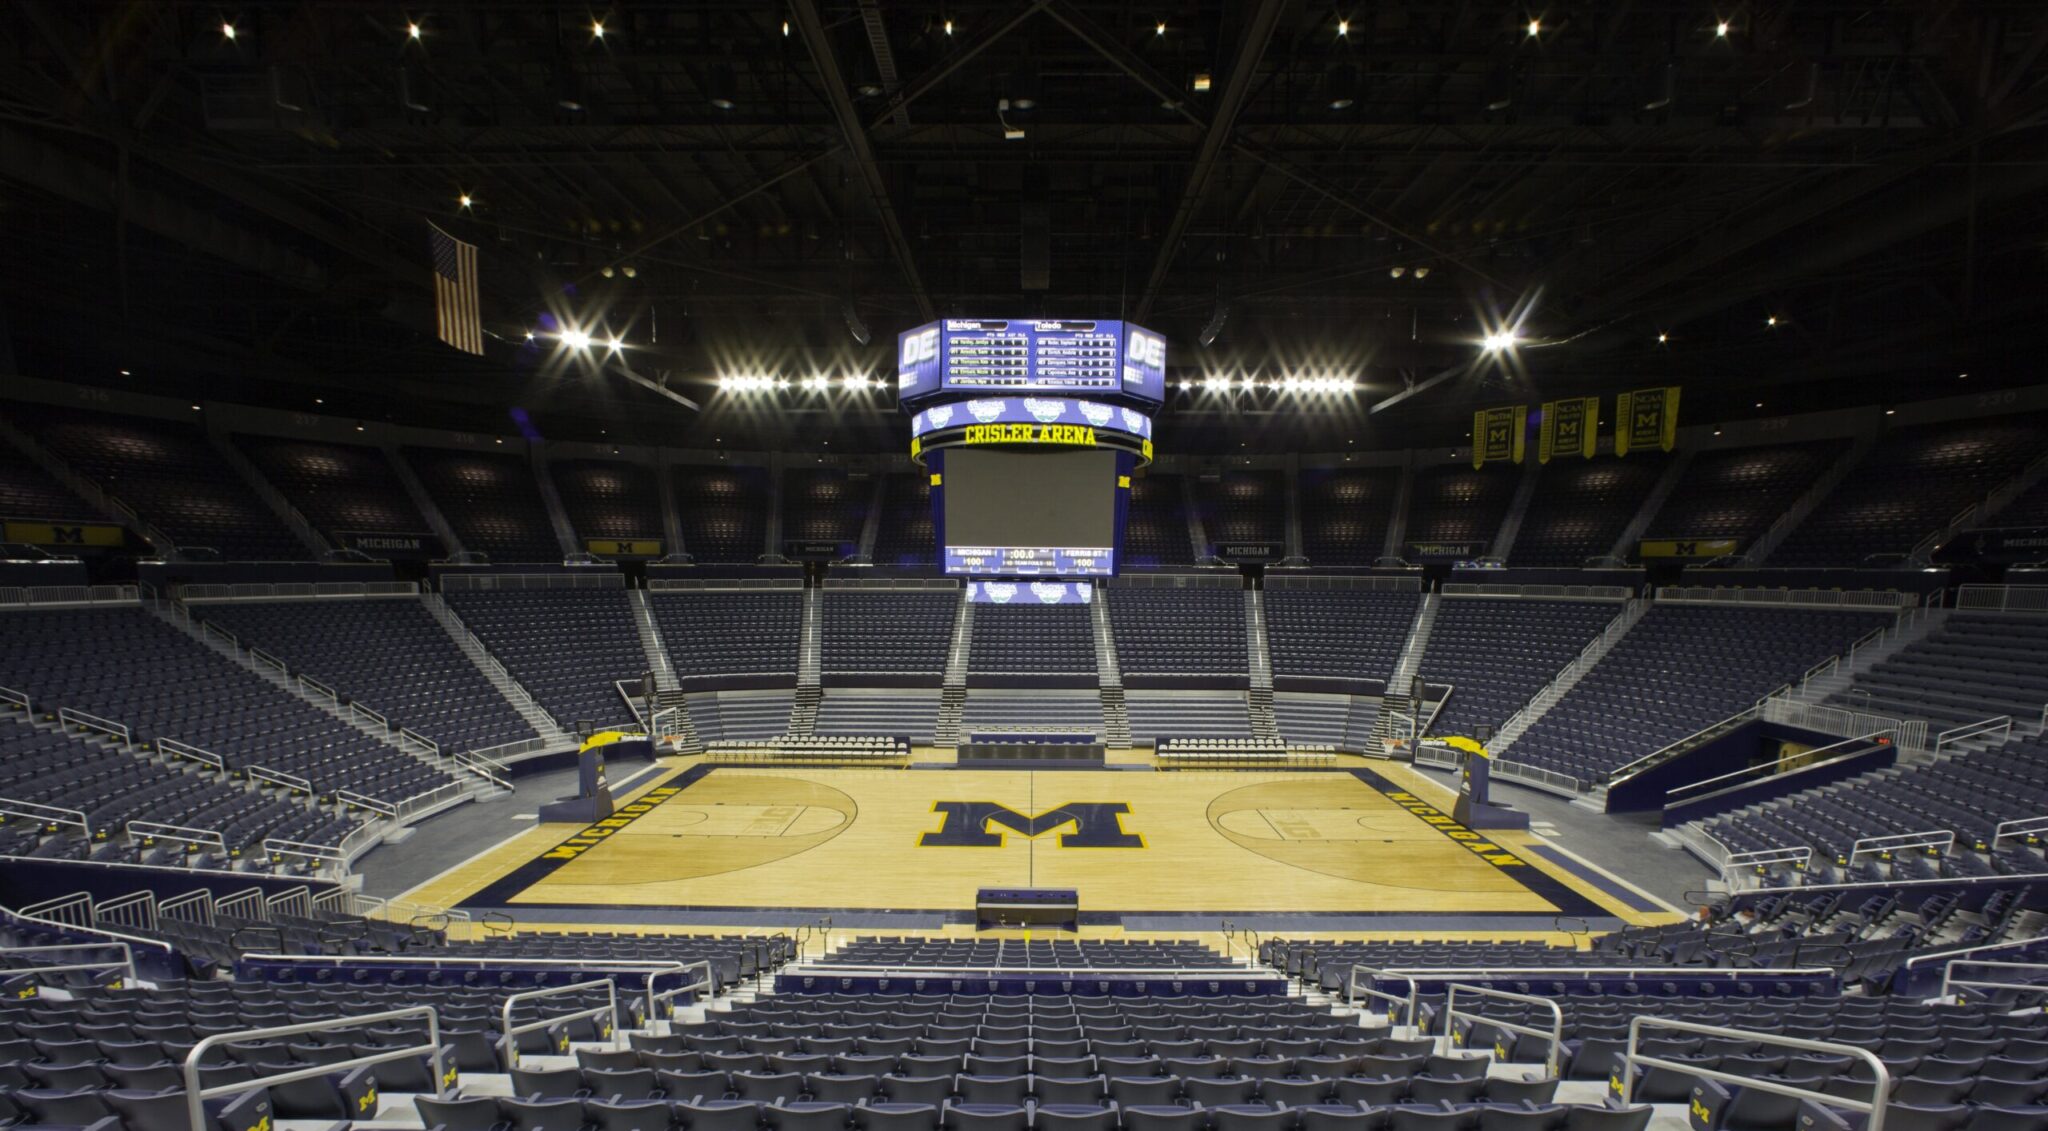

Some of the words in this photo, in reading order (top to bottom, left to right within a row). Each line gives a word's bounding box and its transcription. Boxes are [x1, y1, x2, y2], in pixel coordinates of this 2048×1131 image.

[949, 321, 981, 329] Michigan
[1037, 321, 1062, 329] Toledo
[1637, 413, 1658, 427] M
[965, 424, 1033, 444] CRISLER
[1039, 424, 1096, 445] ARENA
[1559, 422, 1577, 435] M
[1490, 429, 1507, 442] M
[54, 527, 84, 543] M
[356, 537, 420, 550] MICHIGAN
[617, 543, 633, 553] M
[1675, 543, 1697, 554] M
[1226, 546, 1270, 555] MICHIGAN
[1419, 546, 1470, 556] MICHIGAN
[966, 557, 981, 565] 100
[542, 787, 682, 859] MICHIGAN
[914, 800, 1149, 849] M
[1385, 792, 1527, 866] MICHIGAN
[442, 1066, 458, 1088] M
[1609, 1075, 1625, 1096] M
[358, 1088, 376, 1112] M
[1691, 1099, 1710, 1124] M
